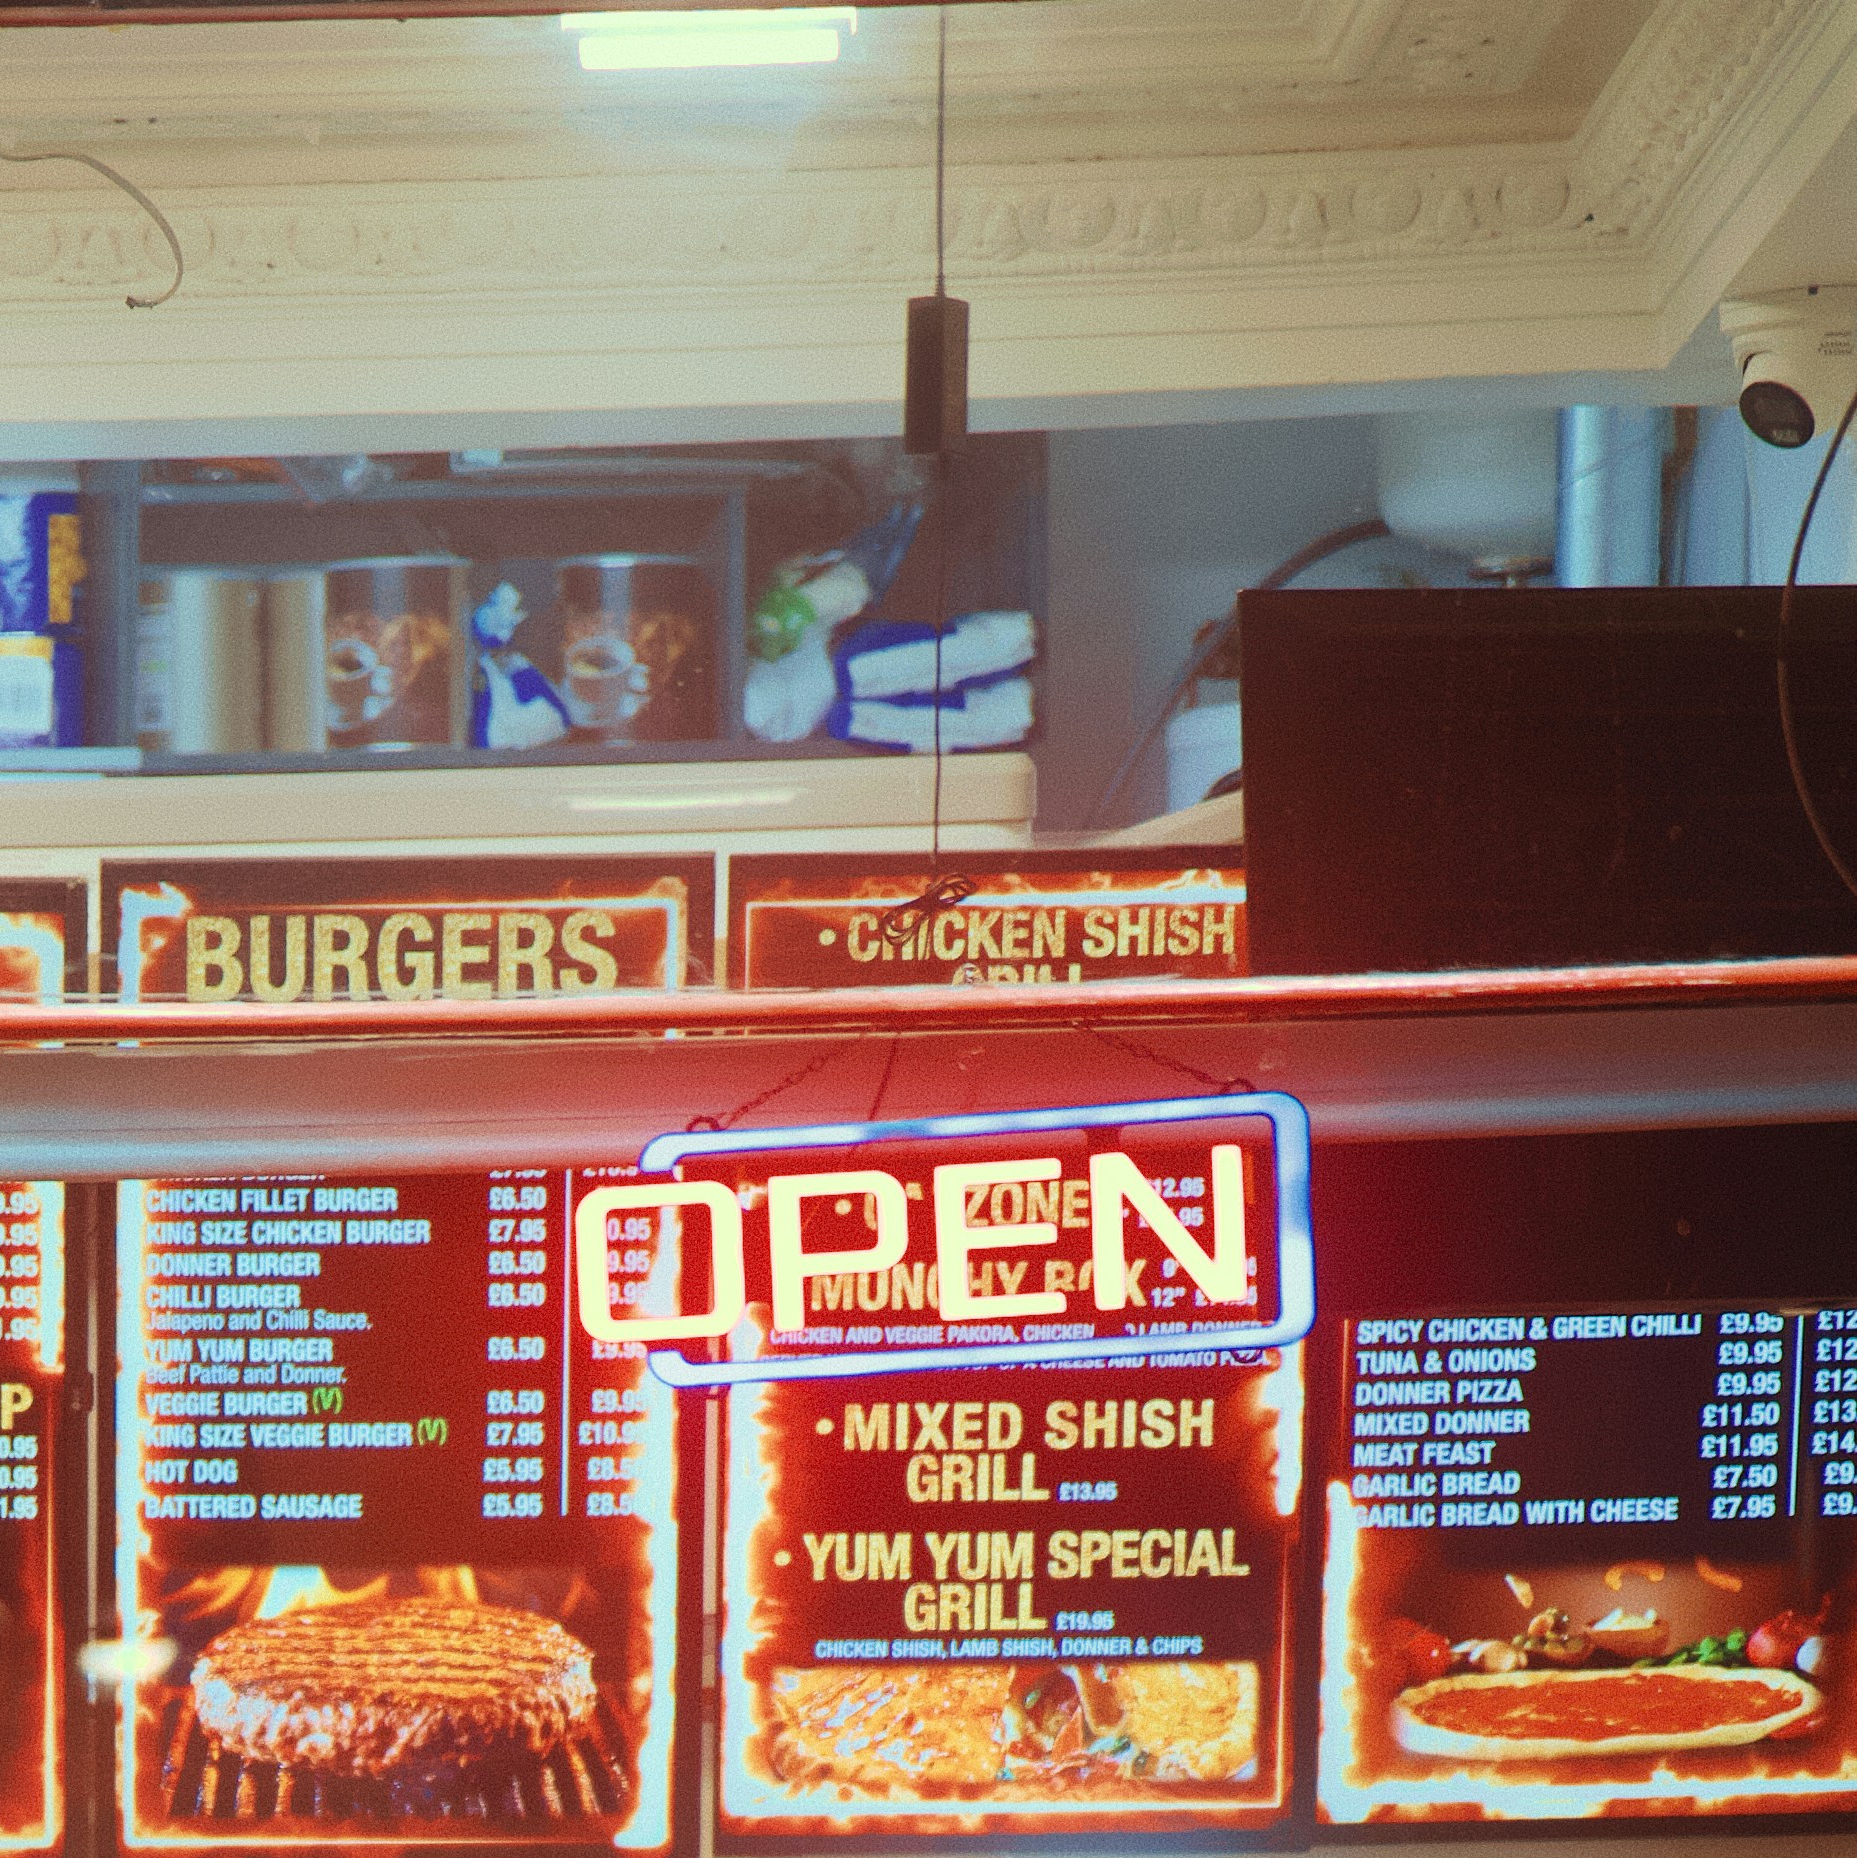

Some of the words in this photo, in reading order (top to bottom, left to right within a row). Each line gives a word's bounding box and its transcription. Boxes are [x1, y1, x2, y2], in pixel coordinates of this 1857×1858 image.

[848, 910, 1066, 962] CHICKEN
[1083, 905, 1235, 957] SHISH
[186, 911, 617, 1002] BURGERS
[147, 1188, 237, 1212] CHICKEN
[241, 1188, 309, 1212] FILLET
[313, 1188, 398, 1212] BURGER
[489, 1187, 546, 1211] £6.50
[575, 1142, 1250, 1341] OPEN
[147, 1253, 231, 1276] DONNER
[236, 1253, 320, 1276] BURGER
[488, 1252, 545, 1275] £6.50
[226, 1310, 261, 1330] and
[266, 1309, 308, 1330] Chilli
[312, 1309, 371, 1331] Sauce.
[1357, 1319, 1424, 1344] SPICY
[1428, 1317, 1523, 1343] CHICKEN
[1527, 1317, 1548, 1340] &
[1553, 1316, 1625, 1339] GREEN
[1631, 1314, 1701, 1337] CHILLI
[1357, 1350, 1418, 1374] TUNA
[1424, 1350, 1442, 1373] &
[1448, 1348, 1536, 1372] ONIONS
[1718, 1340, 1782, 1364] £9.95
[145, 1392, 219, 1416] VEGGIE
[224, 1392, 307, 1416] BURGER
[312, 1387, 342, 1414] (V)
[844, 1402, 1022, 1451] MIXED
[1045, 1400, 1214, 1449] SHISH
[1354, 1412, 1428, 1436] MIXED
[1435, 1409, 1529, 1434] DONNER
[1702, 1403, 1779, 1428] £11.50
[1353, 1443, 1417, 1467] MEAT
[1423, 1441, 1495, 1465] FEAST
[1701, 1434, 1778, 1458] £11.95
[145, 1460, 188, 1482] HOT
[193, 1460, 238, 1482] DOG
[483, 1458, 542, 1482] £5.95
[907, 1454, 1049, 1502] GRILL
[1059, 1481, 1117, 1501] £13.95
[1353, 1474, 1437, 1498] GARLIC
[1442, 1471, 1520, 1495] BREAD
[1713, 1464, 1777, 1489] £7.50
[145, 1495, 256, 1519] BATTERED
[261, 1495, 363, 1518] SAUSAGE
[483, 1493, 542, 1517] £5.95
[1441, 1502, 1519, 1526] BREAD
[1525, 1500, 1584, 1524] WITH
[1590, 1497, 1678, 1522] CHEESE
[1711, 1495, 1775, 1519] £7.95
[804, 1532, 911, 1582] YUM
[926, 1531, 1033, 1580] YUM
[1048, 1529, 1250, 1578] SPECIAL
[904, 1583, 1047, 1632] GRILL
[1056, 1611, 1113, 1631] £19.95
[815, 1639, 889, 1658] CHICKEN
[893, 1639, 946, 1660] SHISH,
[950, 1639, 996, 1657] LAMB
[1001, 1637, 1057, 1659] SHISH,
[1062, 1637, 1131, 1656] DONNER
[1136, 1637, 1148, 1655] &
[1153, 1636, 1203, 1655] CHIPS
